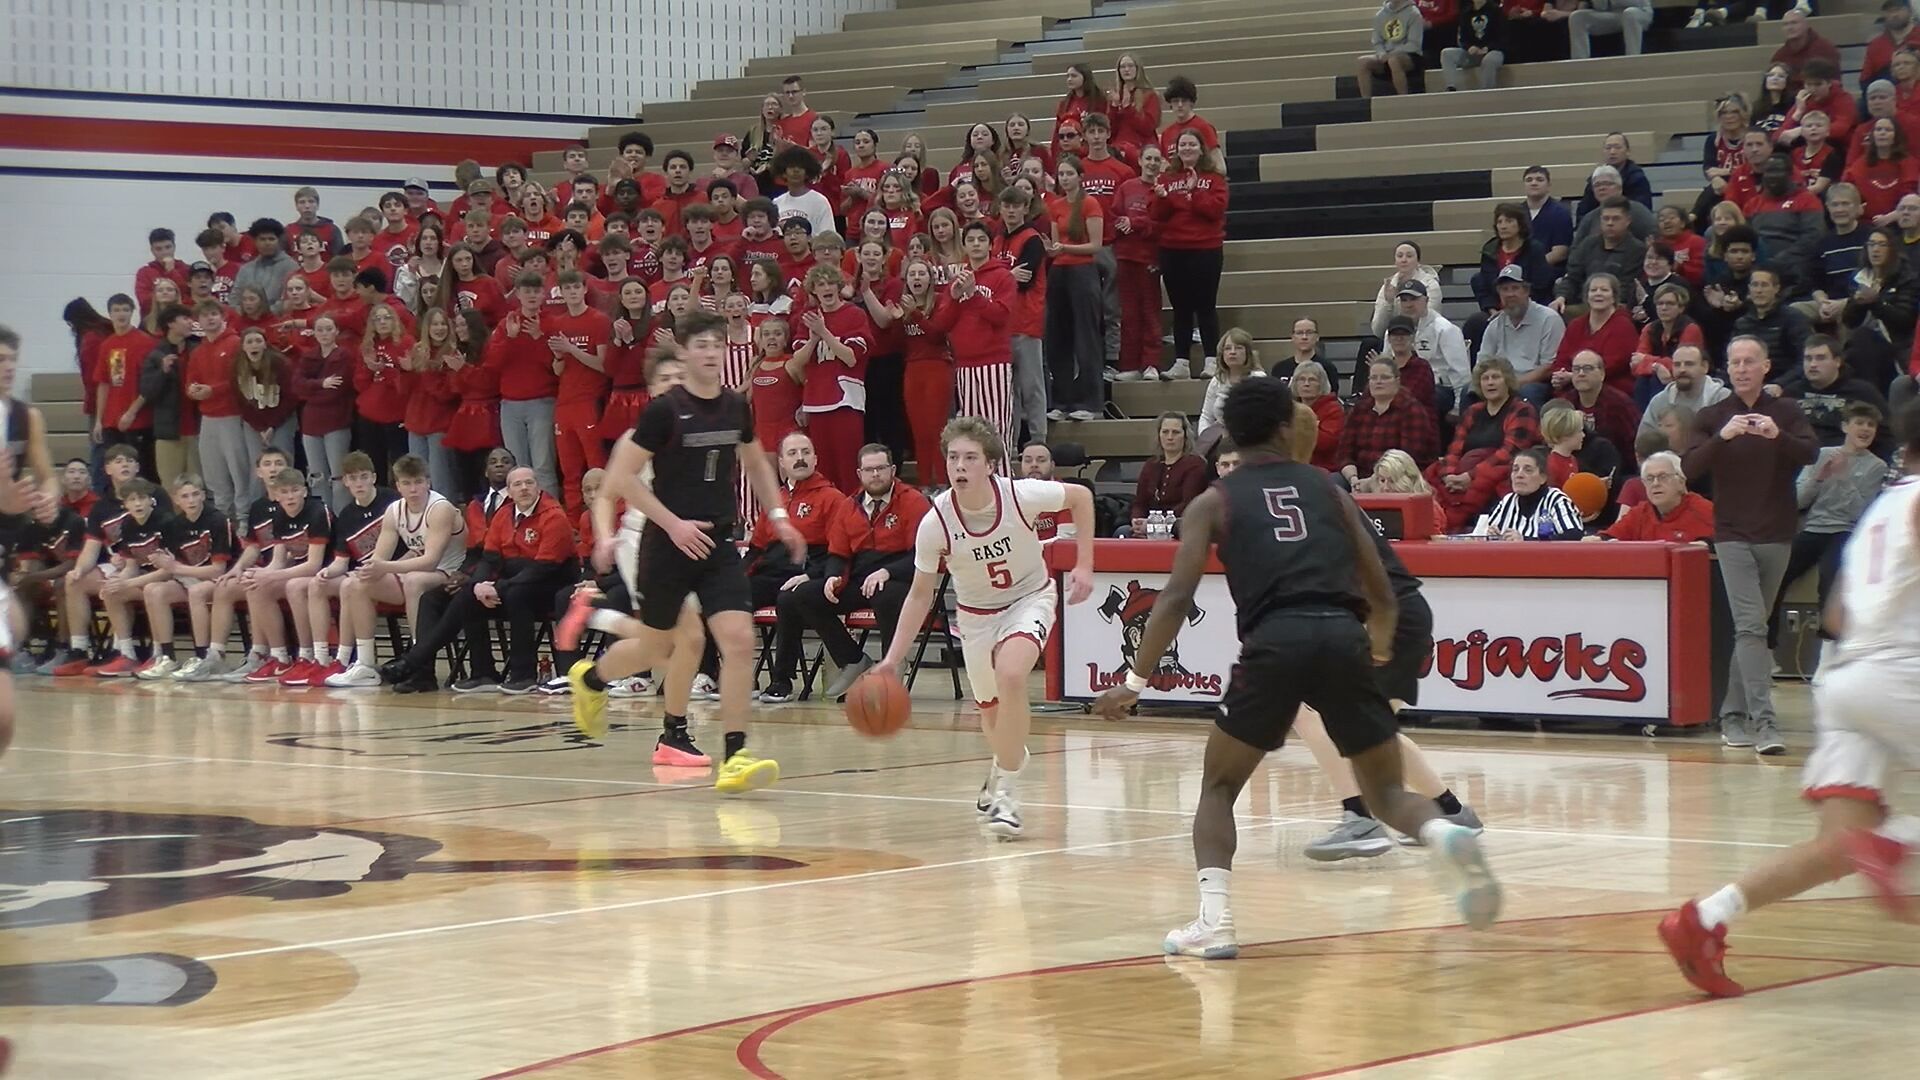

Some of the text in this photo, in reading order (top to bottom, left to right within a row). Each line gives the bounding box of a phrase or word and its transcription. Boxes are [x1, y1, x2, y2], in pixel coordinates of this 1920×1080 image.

[704, 449, 721, 482] 1
[1261, 485, 1309, 543] 5
[971, 535, 1013, 562] EAST
[985, 559, 1014, 590] 5
